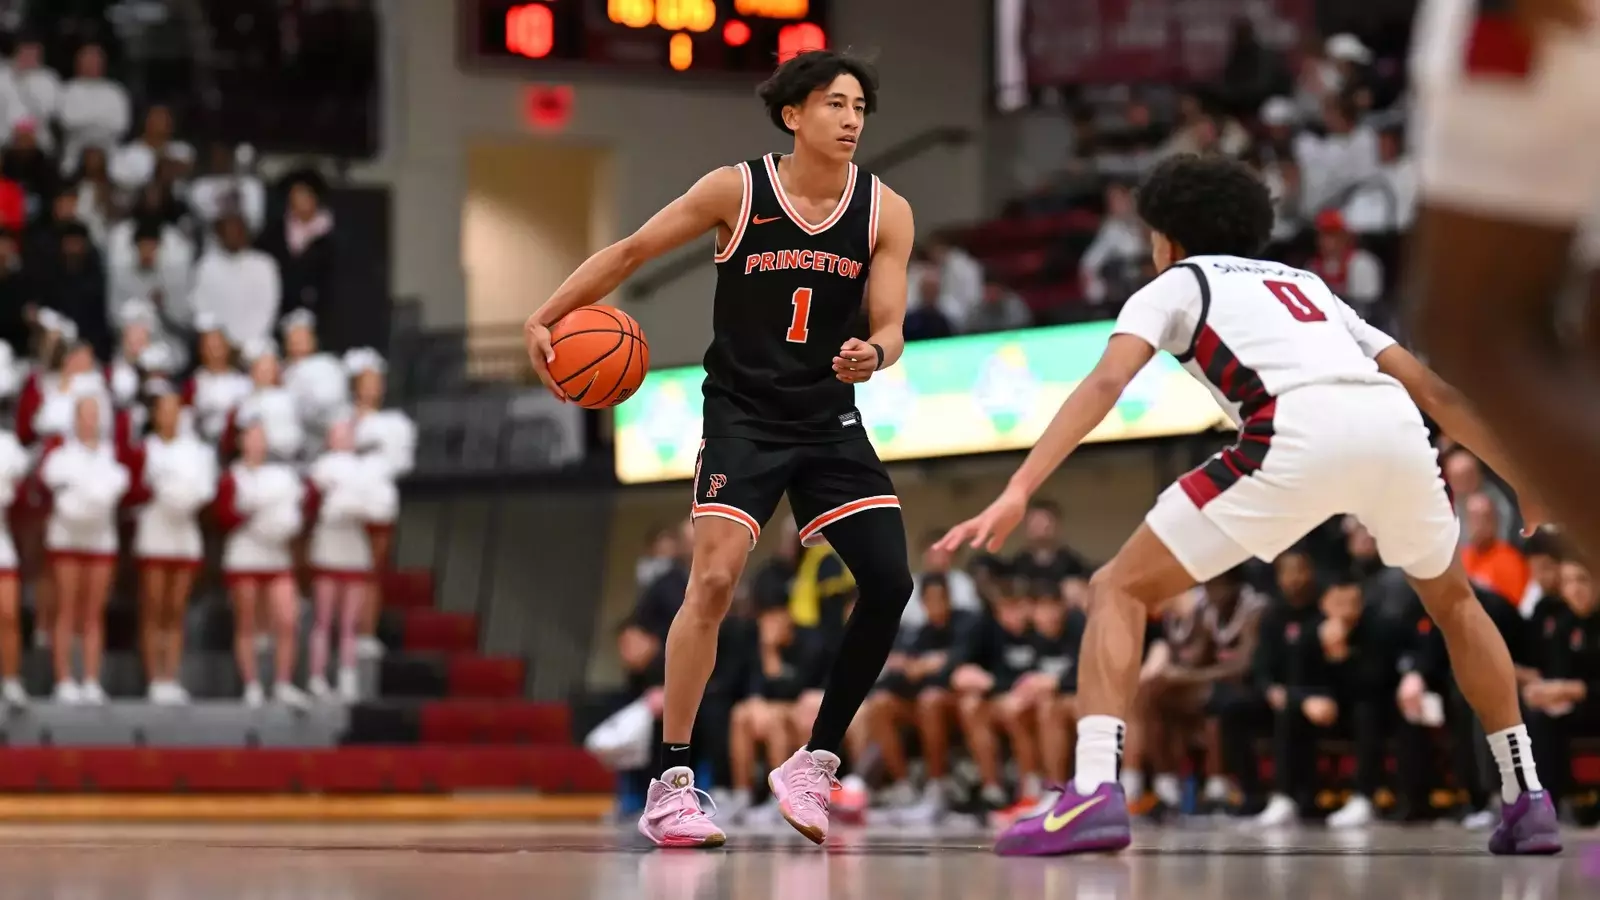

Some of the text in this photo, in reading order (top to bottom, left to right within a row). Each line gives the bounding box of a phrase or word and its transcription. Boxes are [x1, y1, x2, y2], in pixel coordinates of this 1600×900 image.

[745, 250, 862, 279] PRINCETON
[786, 287, 812, 343] 1
[1263, 280, 1328, 322] 0
[706, 474, 727, 497] P
